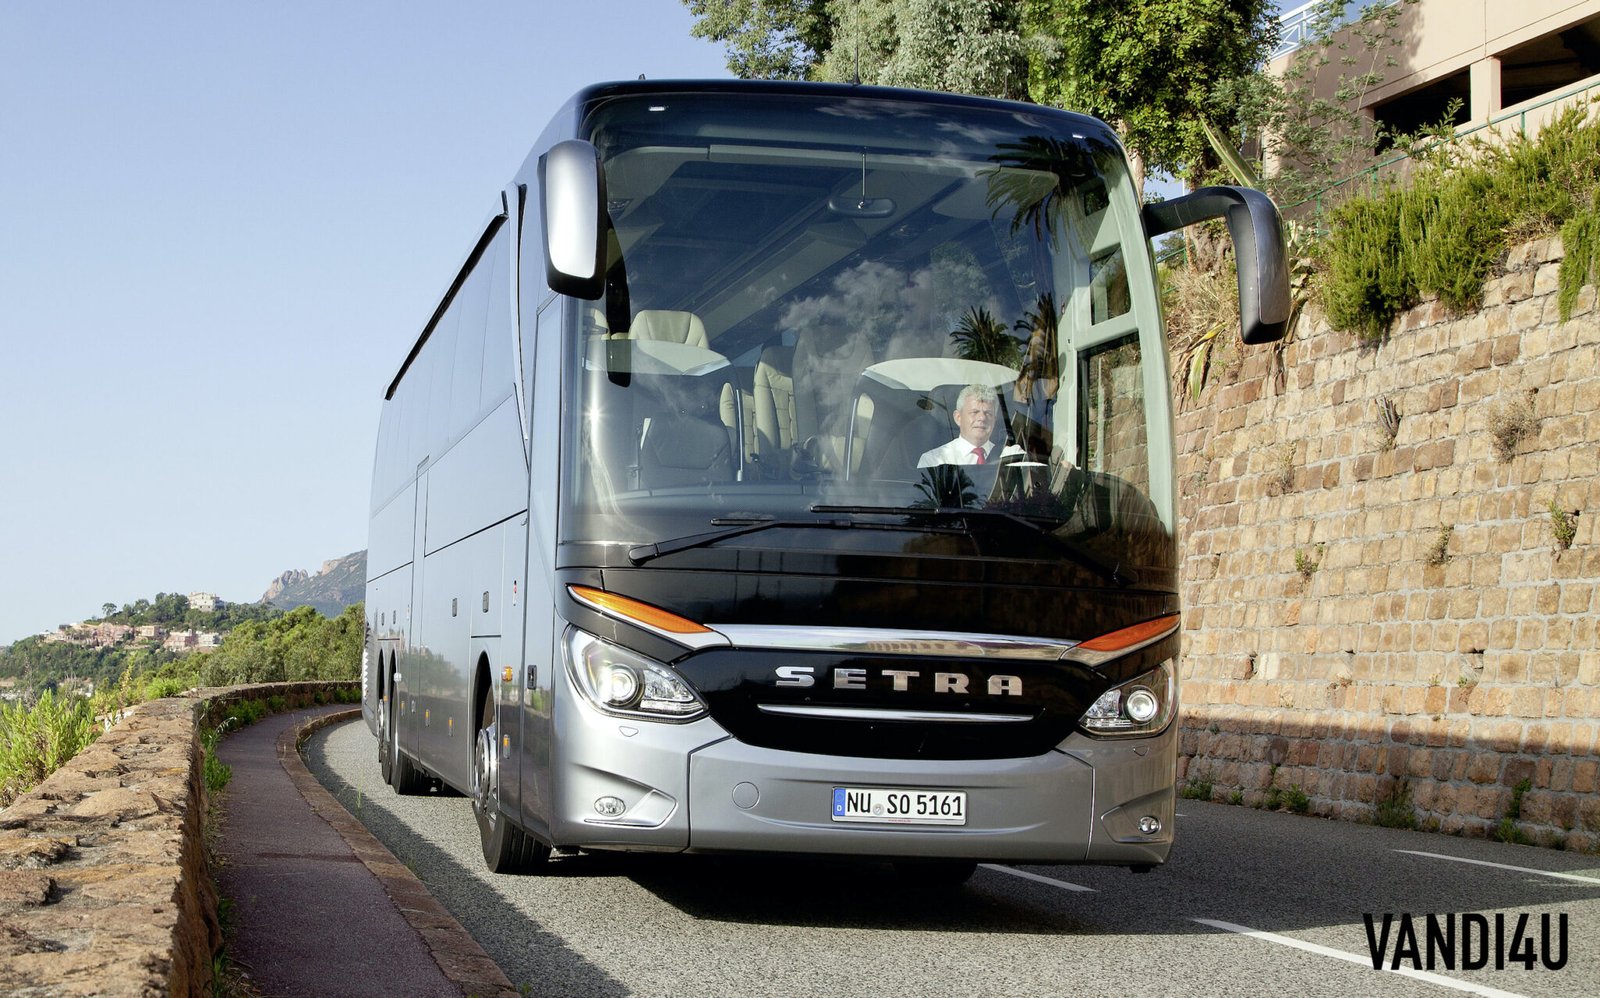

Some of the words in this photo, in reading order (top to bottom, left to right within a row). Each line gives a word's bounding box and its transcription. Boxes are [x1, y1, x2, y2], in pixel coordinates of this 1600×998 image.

[775, 666, 1023, 696] SETRA
[847, 792, 871, 813] NU
[887, 794, 910, 814] SO
[917, 795, 962, 816] 5161
